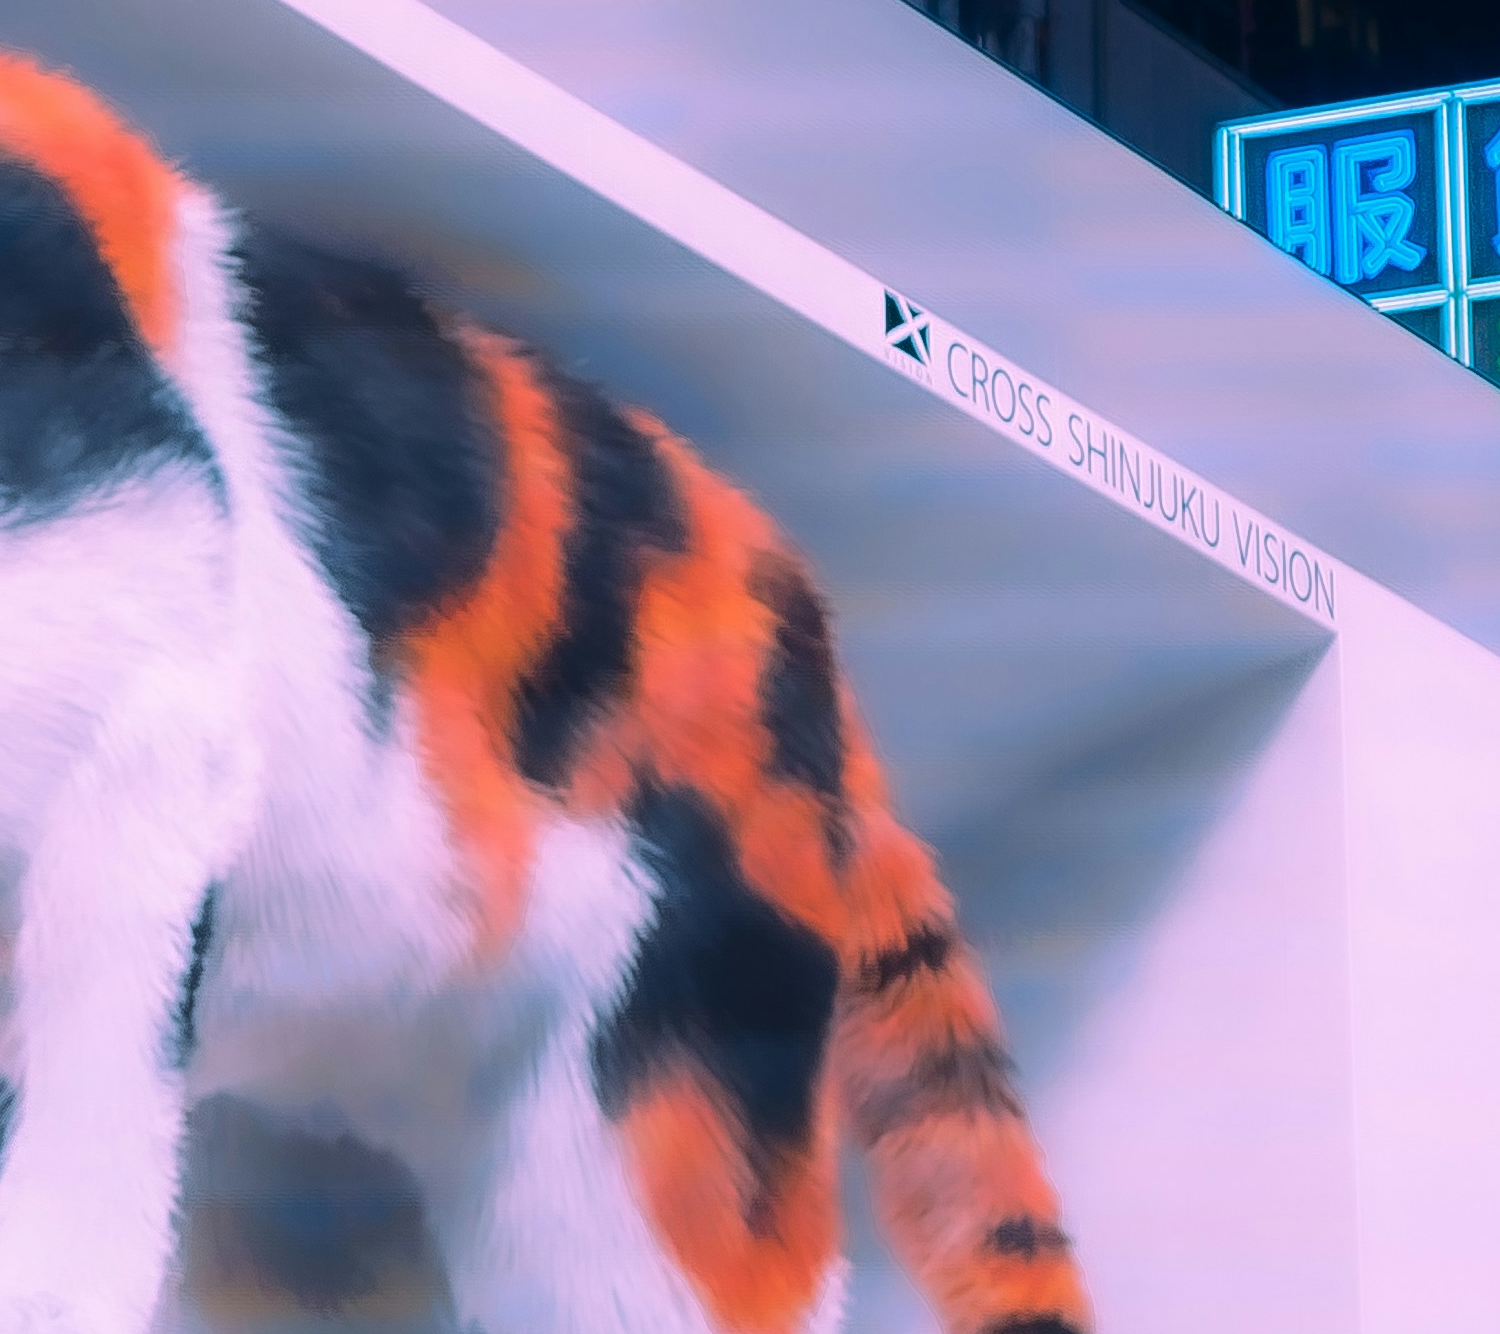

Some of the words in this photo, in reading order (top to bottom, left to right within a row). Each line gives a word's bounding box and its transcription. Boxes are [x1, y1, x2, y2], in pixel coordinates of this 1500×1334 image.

[947, 343, 1053, 447] CROSS
[1068, 414, 1221, 549] SHINJUKU
[1232, 510, 1336, 621] VISION
